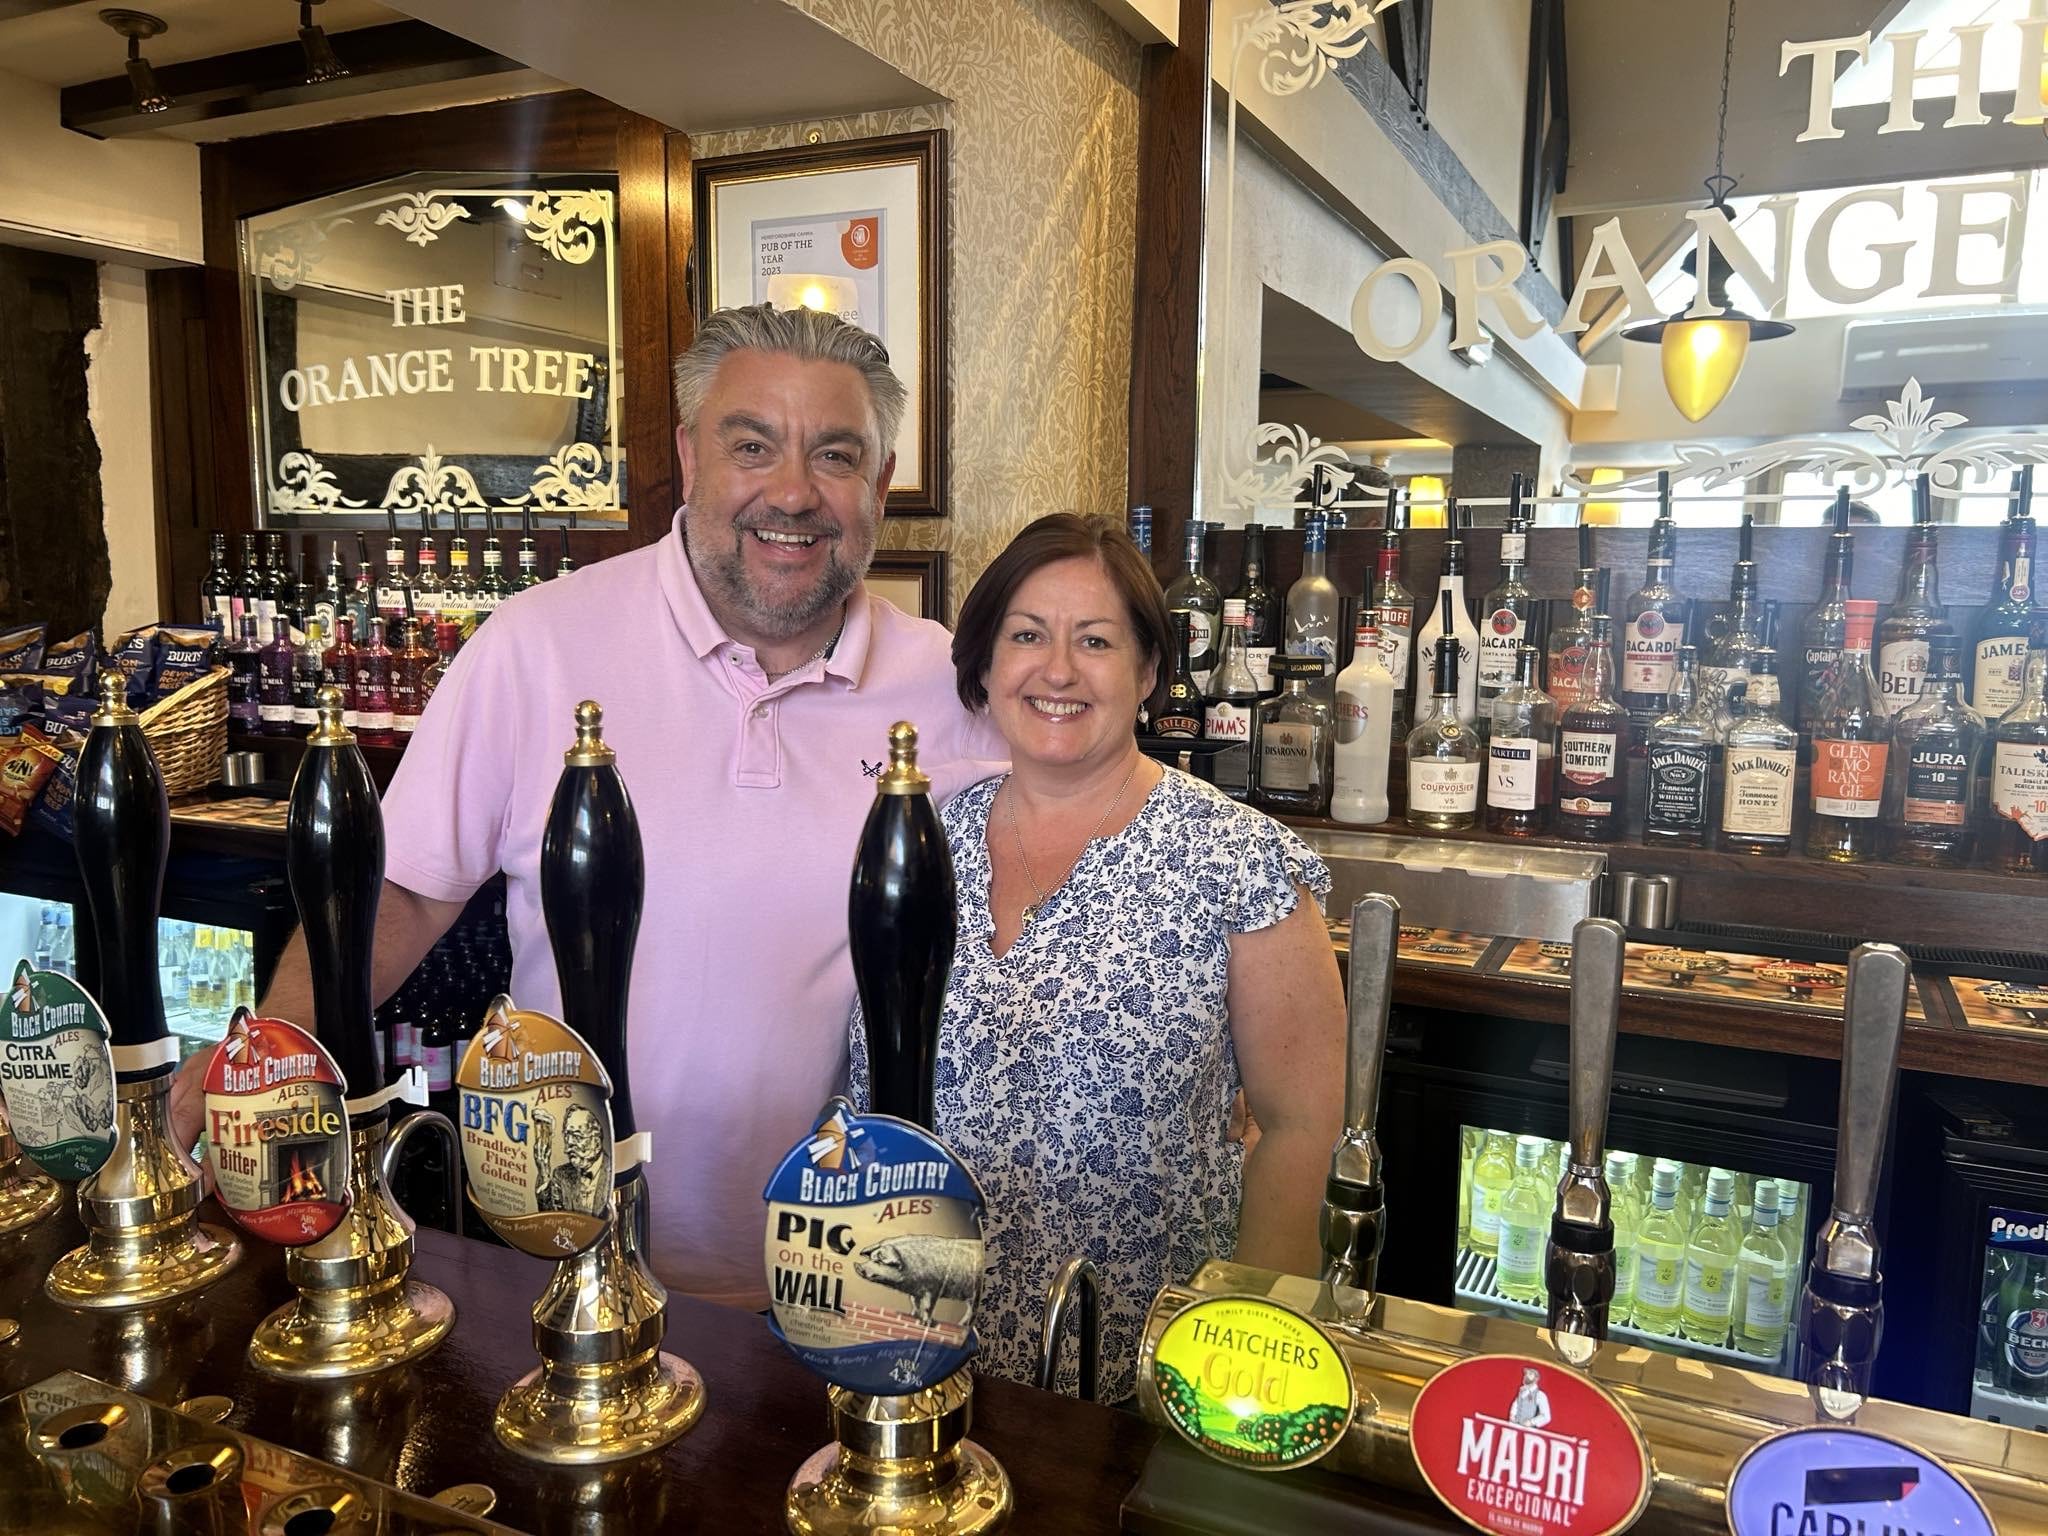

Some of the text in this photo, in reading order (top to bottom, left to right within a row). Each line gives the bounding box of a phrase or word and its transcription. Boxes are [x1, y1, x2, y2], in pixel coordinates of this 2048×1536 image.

[761, 240, 813, 252] PUB OF THE
[761, 254, 784, 264] YEAR
[761, 266, 781, 276] 2023
[1351, 177, 2025, 362] ORANGE
[386, 284, 466, 327] THE
[280, 347, 594, 412] ORANGE TREE
[1376, 609, 1408, 624] RNOFF
[1190, 629, 1208, 638] TINI
[1481, 637, 1524, 649] BACARD
[1981, 643, 2030, 660] JAME
[166, 651, 203, 662] BURTS
[1552, 677, 1581, 688] BACA
[1882, 672, 1922, 695] BEL
[1156, 718, 1199, 731] BAILEYS
[1206, 716, 1247, 735] PIMM'S
[1265, 746, 1307, 756] DISARONNO
[1491, 748, 1530, 759] MARTELL
[1564, 741, 1611, 755] SOUTHERN
[1829, 743, 1871, 759] GLEN
[1565, 754, 1608, 766] COMFORT
[1652, 755, 1674, 770] JACK
[1732, 757, 1791, 777] JACK DANIEL'S
[1842, 758, 1870, 772] MO
[1912, 752, 1967, 765] JURA
[1828, 770, 1860, 784] RAN
[1931, 772, 1945, 782] 10
[2000, 766, 2048, 777] TALISK
[1420, 783, 1474, 792] COURVOISIER
[1498, 775, 1514, 788] VS
[1840, 784, 1865, 797] GIE
[2034, 800, 2047, 813] 10
[11, 1003, 86, 1037] BLACK COUNTRY
[54, 1031, 80, 1048] ALES
[6, 1043, 56, 1060] CITRA
[1, 1062, 73, 1080] SUBLIME
[223, 1053, 318, 1092] BLACK COUNTRY
[480, 1051, 582, 1088] BLACK COUNTRY
[277, 1085, 309, 1104] ALES
[535, 1085, 573, 1106] ALES
[210, 1096, 341, 1146] Fireside
[463, 1094, 529, 1146] BFG
[466, 1131, 528, 1160] Bradley's
[220, 1149, 258, 1177] Bitter
[485, 1150, 528, 1174] Finest
[480, 1163, 528, 1187] Golden
[800, 1161, 949, 1204] BLACK COUNTRY
[878, 1199, 933, 1224] ALES
[557, 1227, 574, 1240] ABV
[777, 1211, 857, 1256] PIG
[1991, 1217, 2048, 1241] Prodi
[552, 1234, 579, 1253] 4.2%
[779, 1250, 844, 1274] on the
[774, 1266, 847, 1319] WALL
[1192, 1318, 1321, 1370] THATCHERS
[2008, 1332, 2048, 1348] BEC
[894, 1358, 920, 1372] ABV
[889, 1367, 923, 1387] 4.3%
[1204, 1352, 1290, 1407] Gold
[1457, 1417, 1591, 1506] MADRÍ
[1467, 1478, 1573, 1527] EXCEPCIONAL
